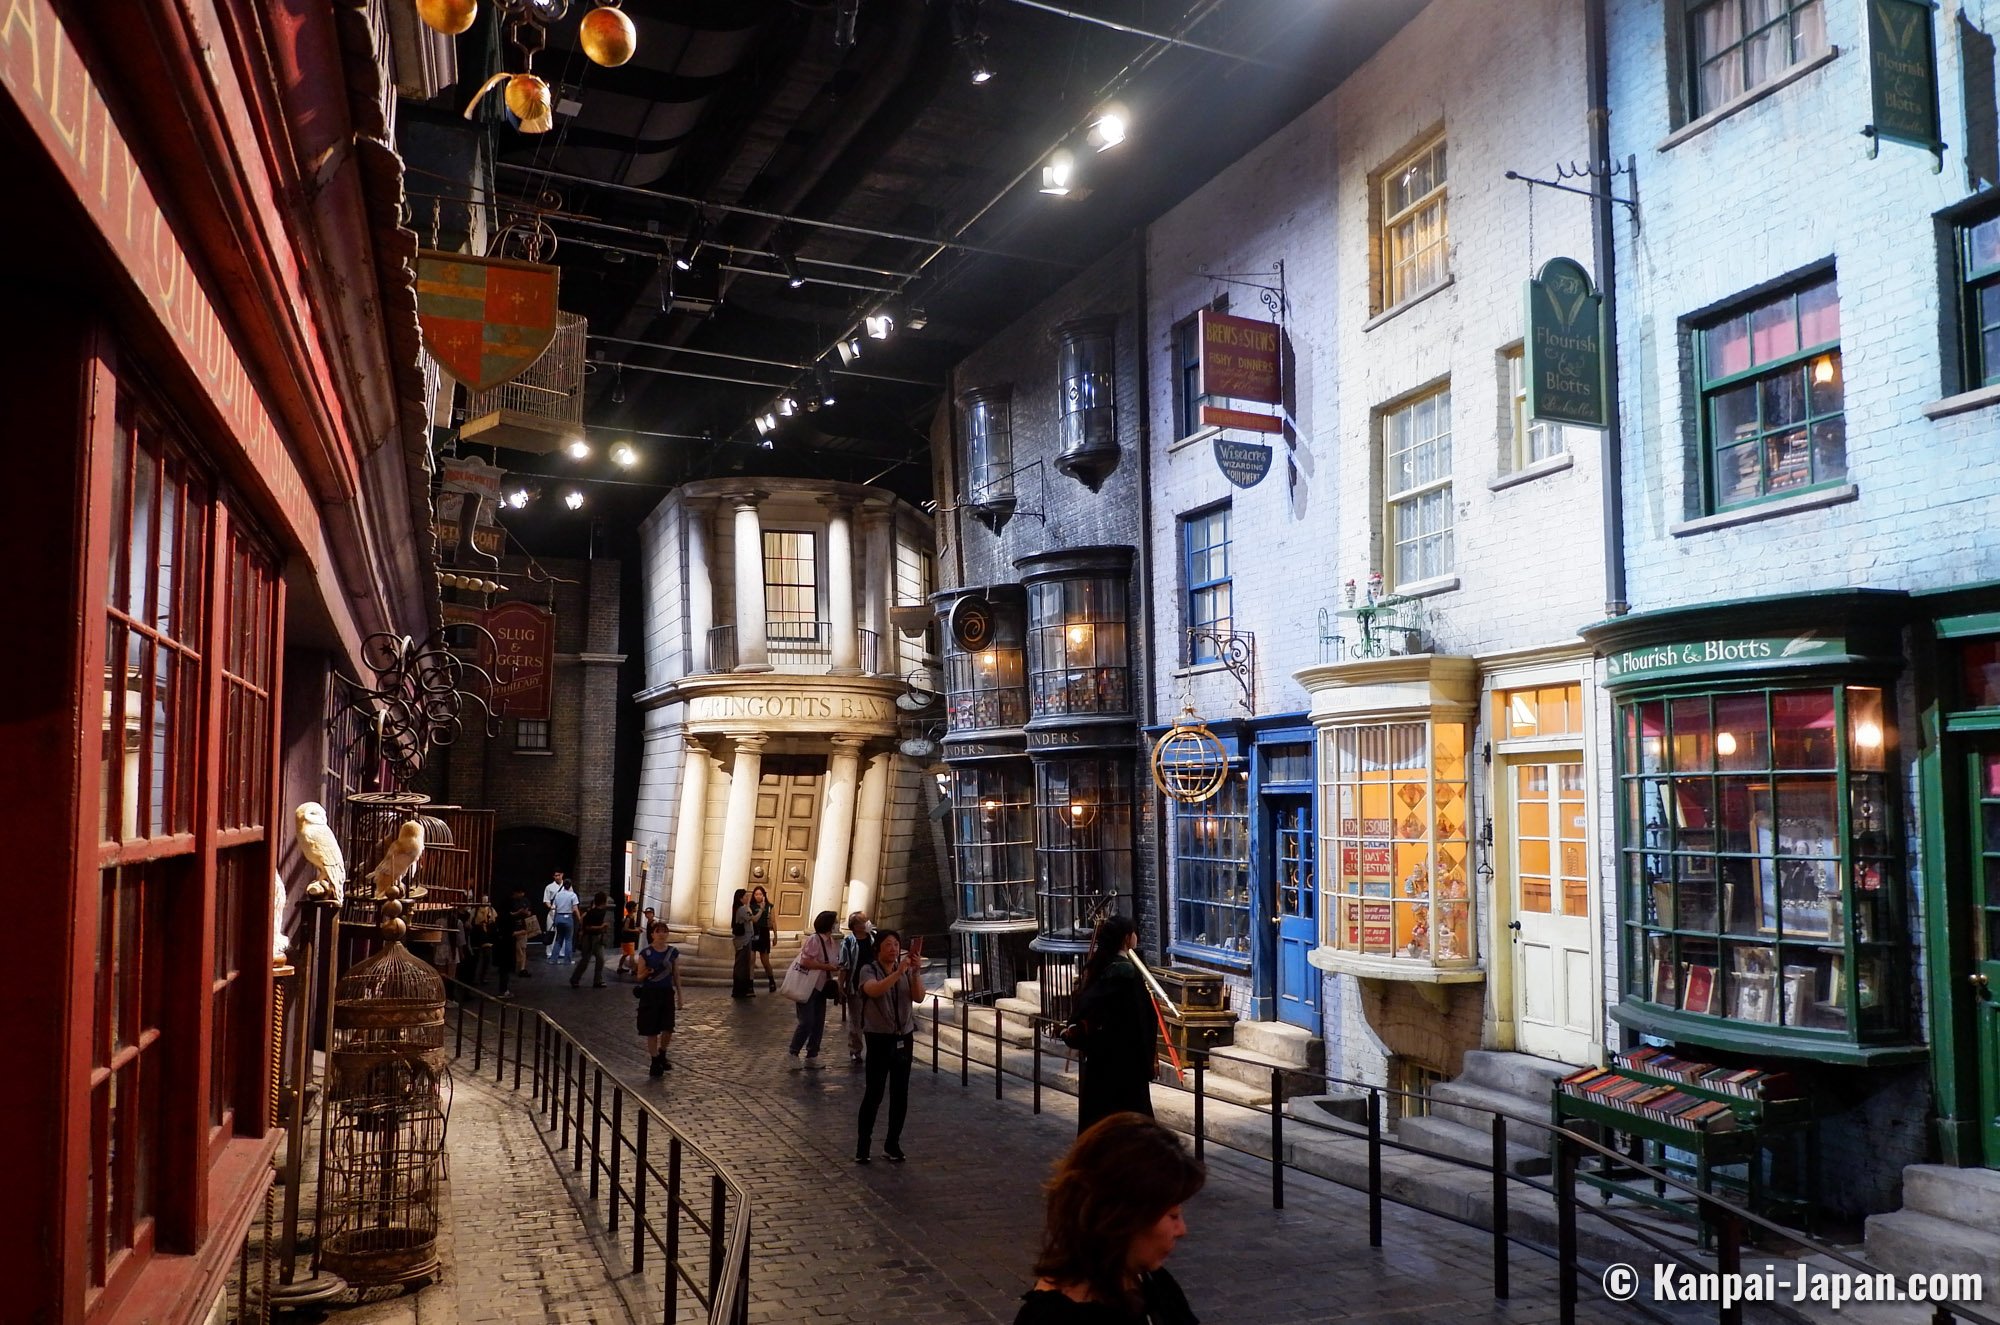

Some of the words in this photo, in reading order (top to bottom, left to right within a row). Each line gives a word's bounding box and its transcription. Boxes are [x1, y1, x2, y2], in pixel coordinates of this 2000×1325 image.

[1206, 321, 1237, 346] BREWS
[1243, 328, 1275, 353] STEWS
[1536, 326, 1597, 353] Flourish
[1208, 352, 1233, 368] FISHY
[1238, 357, 1274, 374] DINNERS
[1546, 371, 1591, 396] Blotts
[1223, 460, 1264, 471] WIZARDING
[498, 627, 535, 641] SLUG
[486, 653, 544, 668] JGGERS
[1622, 644, 1678, 673] Flourish
[1682, 643, 1702, 664] &
[1704, 639, 1771, 662] Blotts
[699, 695, 832, 719] GRINGOTTS
[841, 697, 889, 721] BANK
